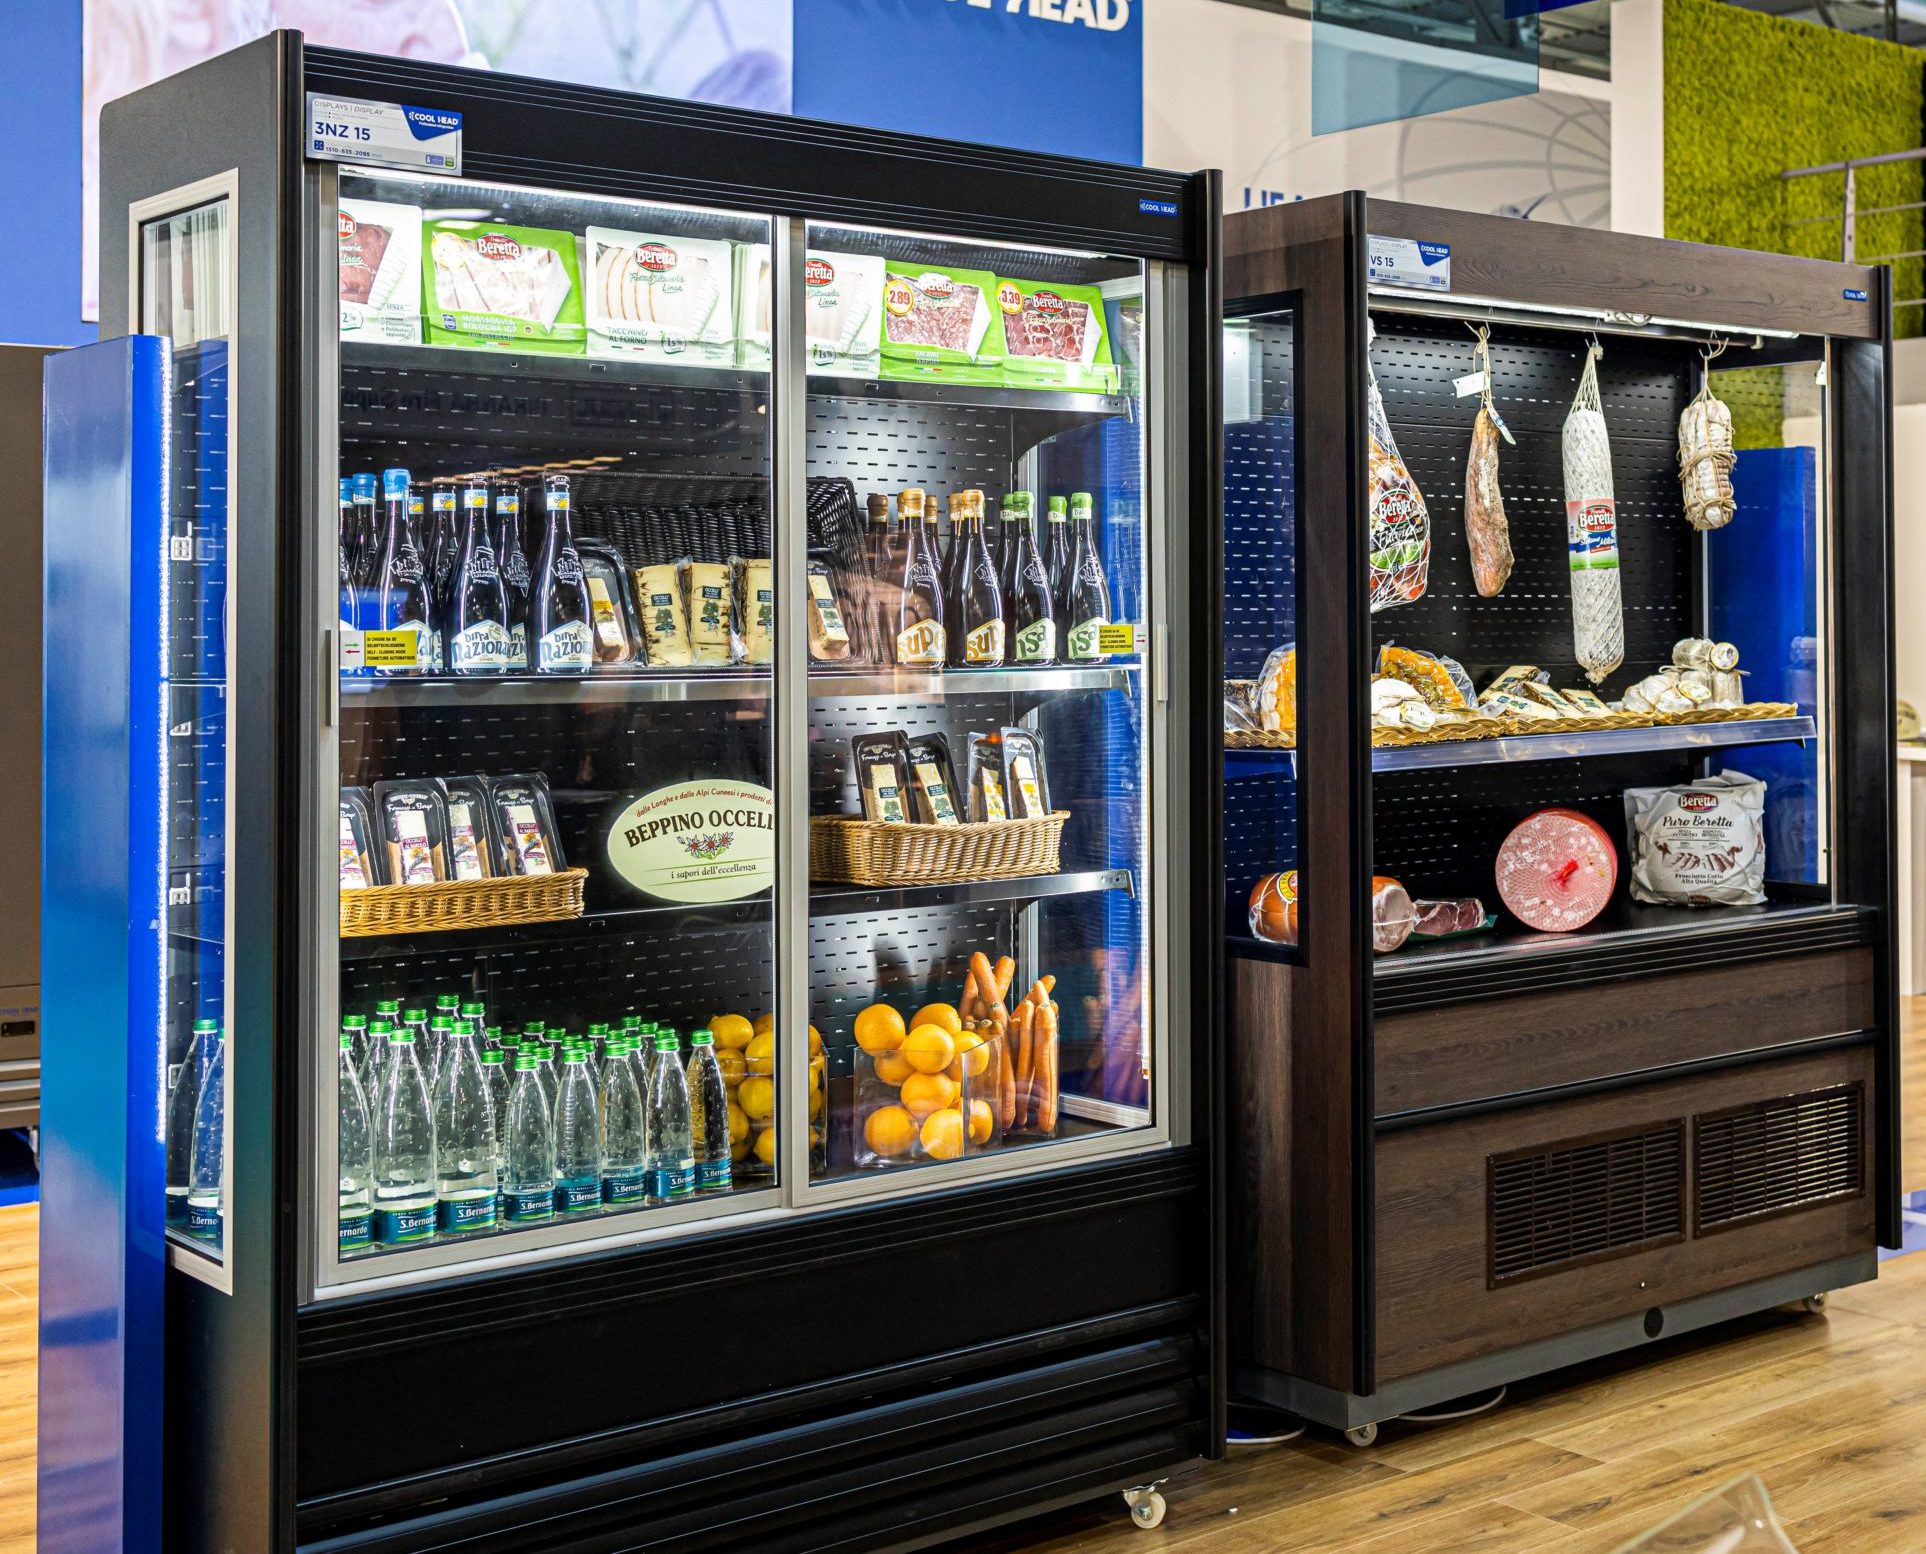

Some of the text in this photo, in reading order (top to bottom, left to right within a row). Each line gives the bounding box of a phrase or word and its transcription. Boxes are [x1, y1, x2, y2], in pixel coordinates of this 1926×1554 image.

[314, 100, 349, 111] DISPLAYS
[354, 106, 384, 116] DISPLAY
[414, 113, 459, 126] COOL HEAD
[315, 121, 371, 141] 3NZ 15
[477, 238, 521, 258] Beretta
[636, 250, 676, 267] Beretta
[1370, 255, 1394, 267] VS 15
[806, 267, 833, 280] eretta
[1032, 295, 1064, 309] Beretta
[620, 337, 647, 345] FORNO
[1579, 511, 1615, 528] Beretta
[464, 631, 490, 643] birra
[554, 631, 578, 642] birra
[636, 804, 651, 818] dalle
[651, 795, 674, 809] Langhe
[680, 790, 695, 800] dalle
[696, 789, 710, 798] Alpi
[711, 788, 736, 797] Cuneesi
[740, 791, 765, 803] prodotti
[1680, 795, 1718, 807] Beretta
[708, 809, 773, 830] OCCELL
[1663, 815, 1734, 827] Puro Beretta
[624, 811, 704, 848] BEPPINO
[671, 863, 756, 880] i sapori dell'eccellenza
[614, 1182, 644, 1193] S.Bernard
[458, 1204, 495, 1218] S.Bernardo
[191, 1215, 218, 1226] S.Berna
[339, 1225, 368, 1237] ernardo
